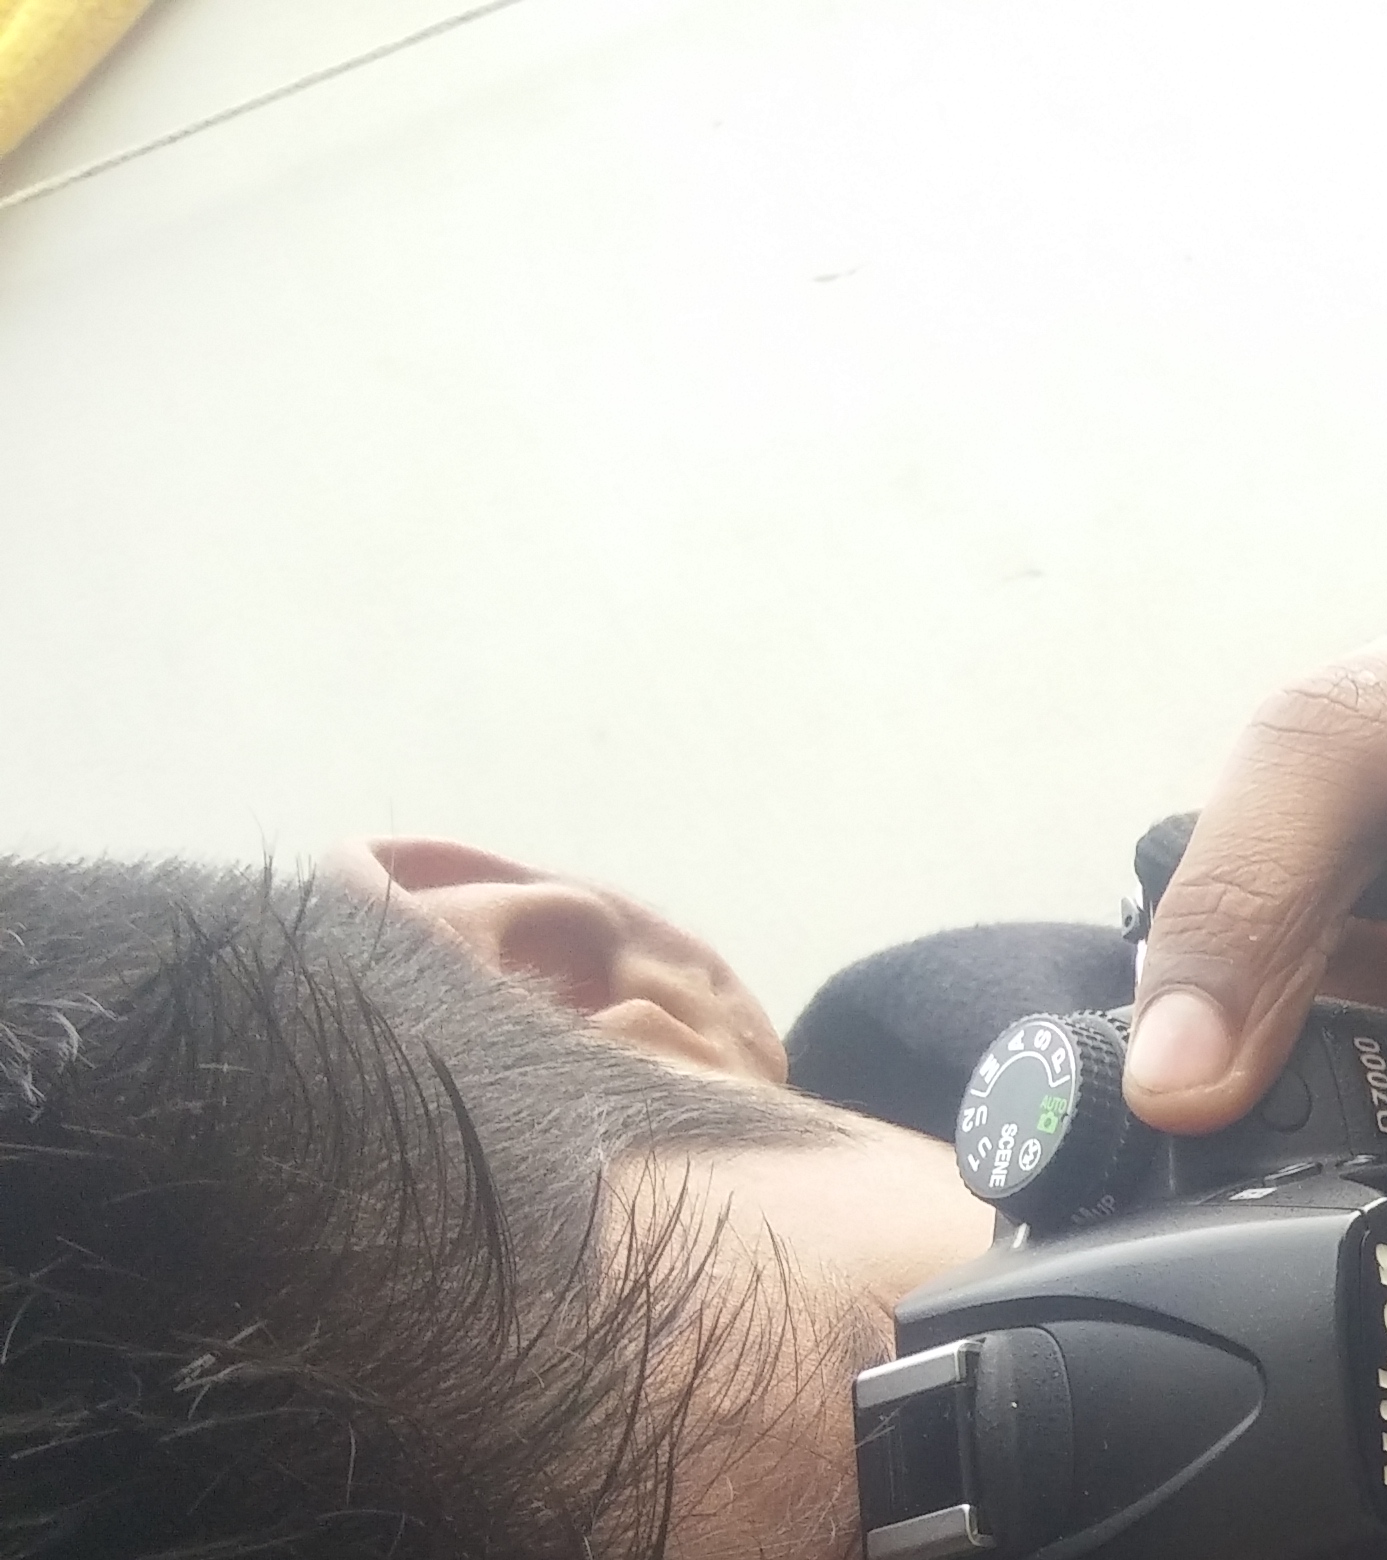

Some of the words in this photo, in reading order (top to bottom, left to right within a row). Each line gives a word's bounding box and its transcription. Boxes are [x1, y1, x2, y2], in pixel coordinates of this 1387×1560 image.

[1007, 1029, 1025, 1051] A
[1033, 1029, 1052, 1051] S
[979, 1053, 1000, 1084] M
[1051, 1047, 1066, 1074] P
[961, 1105, 988, 1132] U2
[1040, 1095, 1068, 1115] AUTO
[967, 1136, 993, 1172] U1
[989, 1123, 1018, 1188] SCENE
